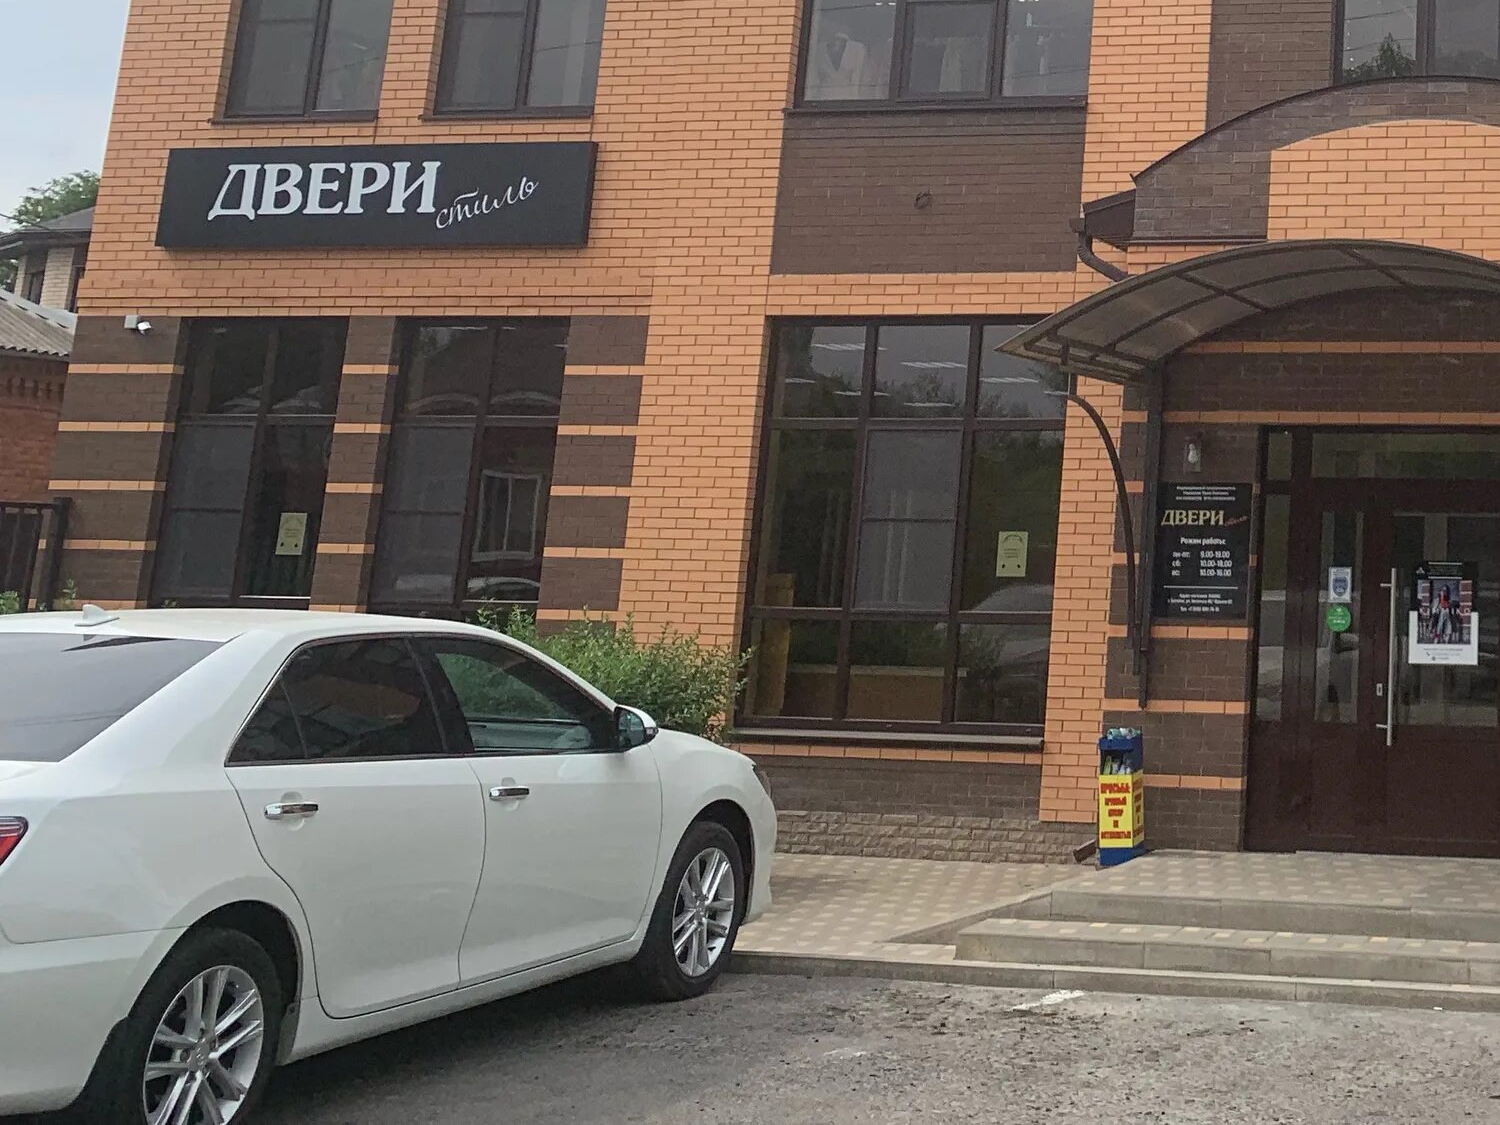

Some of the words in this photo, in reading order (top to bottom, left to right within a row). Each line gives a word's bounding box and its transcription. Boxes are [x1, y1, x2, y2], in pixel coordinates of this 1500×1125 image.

[207, 161, 442, 221] ДВЕРИ
[435, 176, 540, 230] стиль
[1161, 510, 1224, 526] ДВЕРИ
